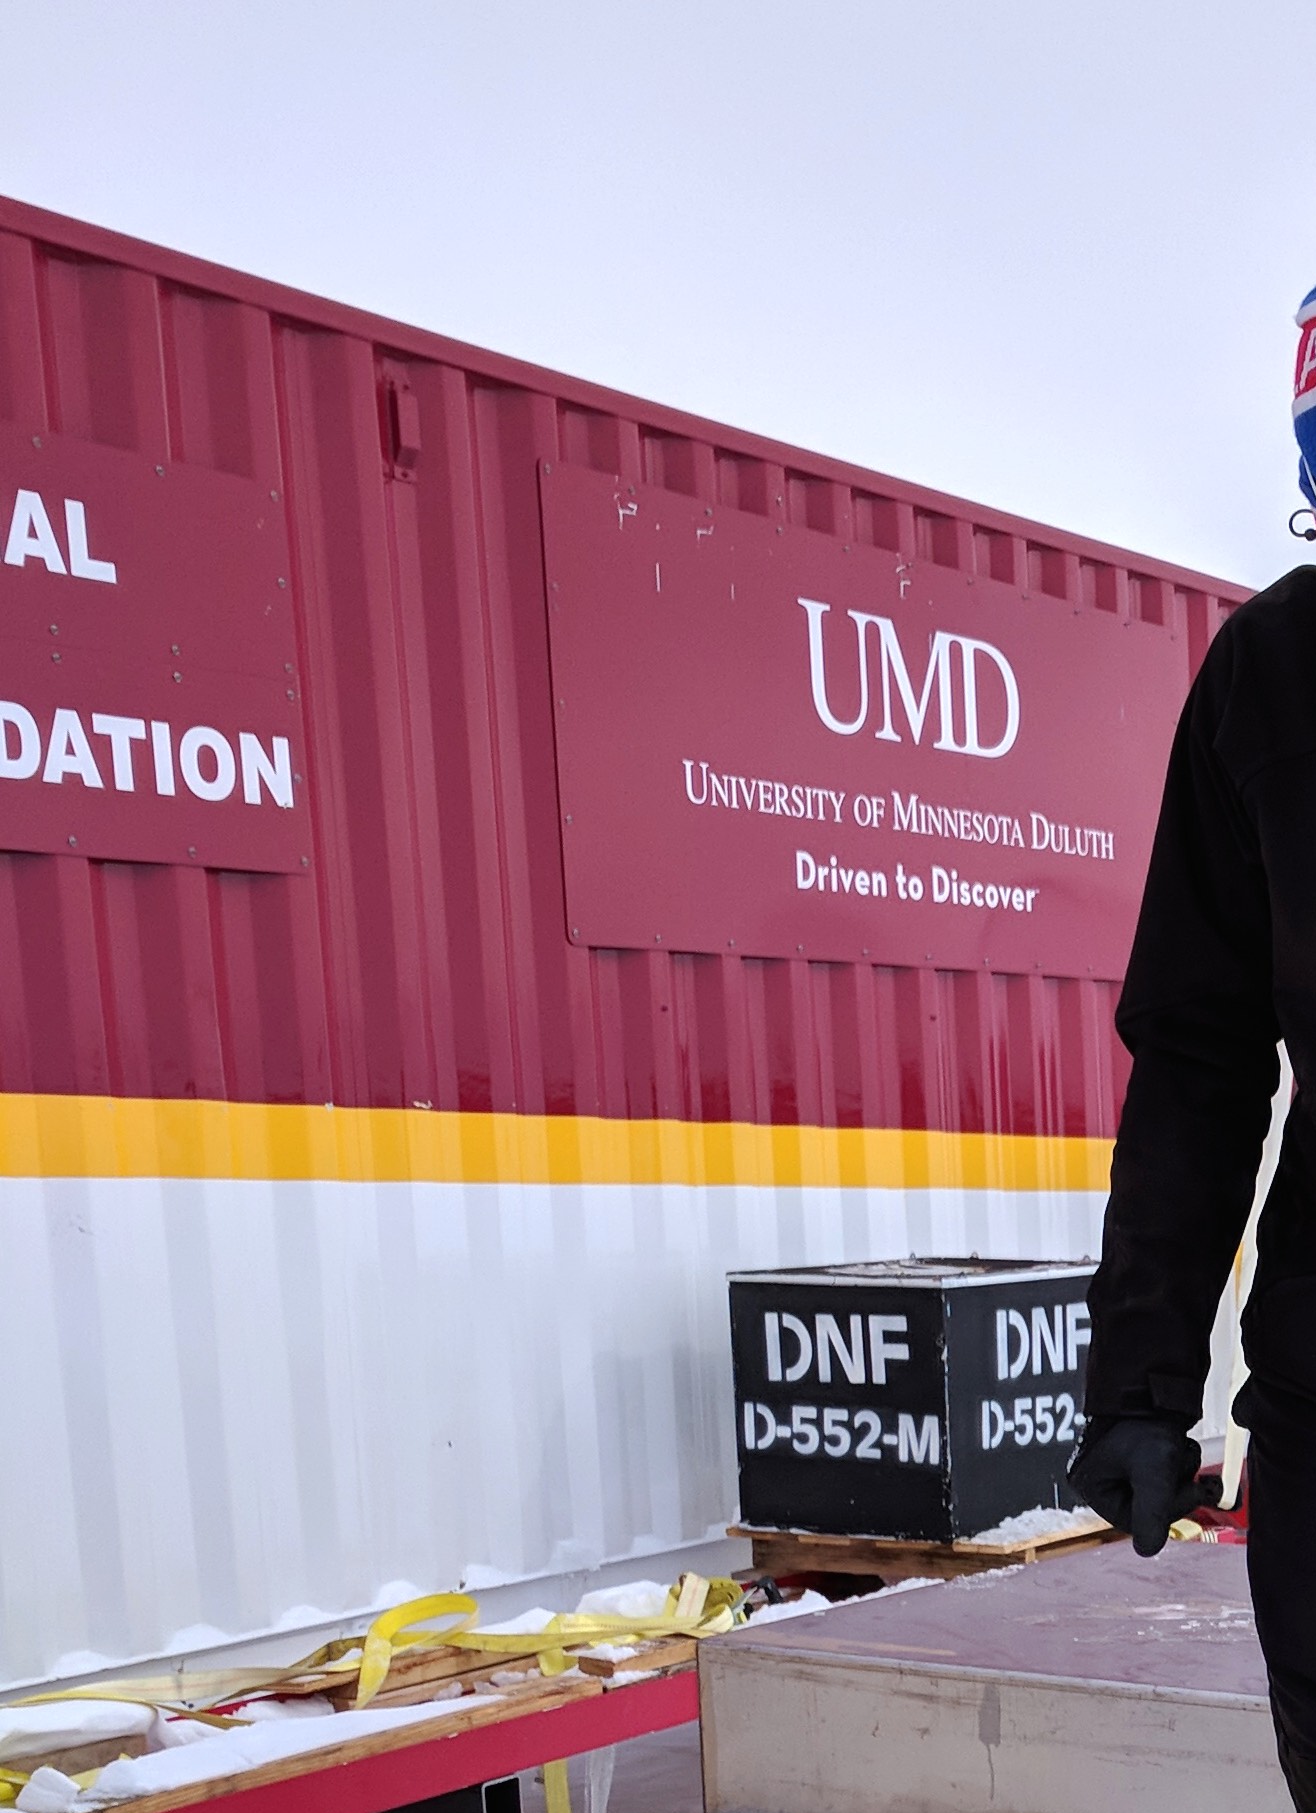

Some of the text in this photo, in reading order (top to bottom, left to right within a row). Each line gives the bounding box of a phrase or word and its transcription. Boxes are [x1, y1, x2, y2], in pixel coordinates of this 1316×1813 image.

[4, 489, 117, 584] AL
[797, 597, 1020, 759] UMD
[0, 701, 294, 808] DATION
[795, 850, 1036, 913] Driven to Discover
[764, 1311, 911, 1385] DNF
[996, 1302, 1093, 1380] DNF
[744, 1401, 940, 1465] D-552-M
